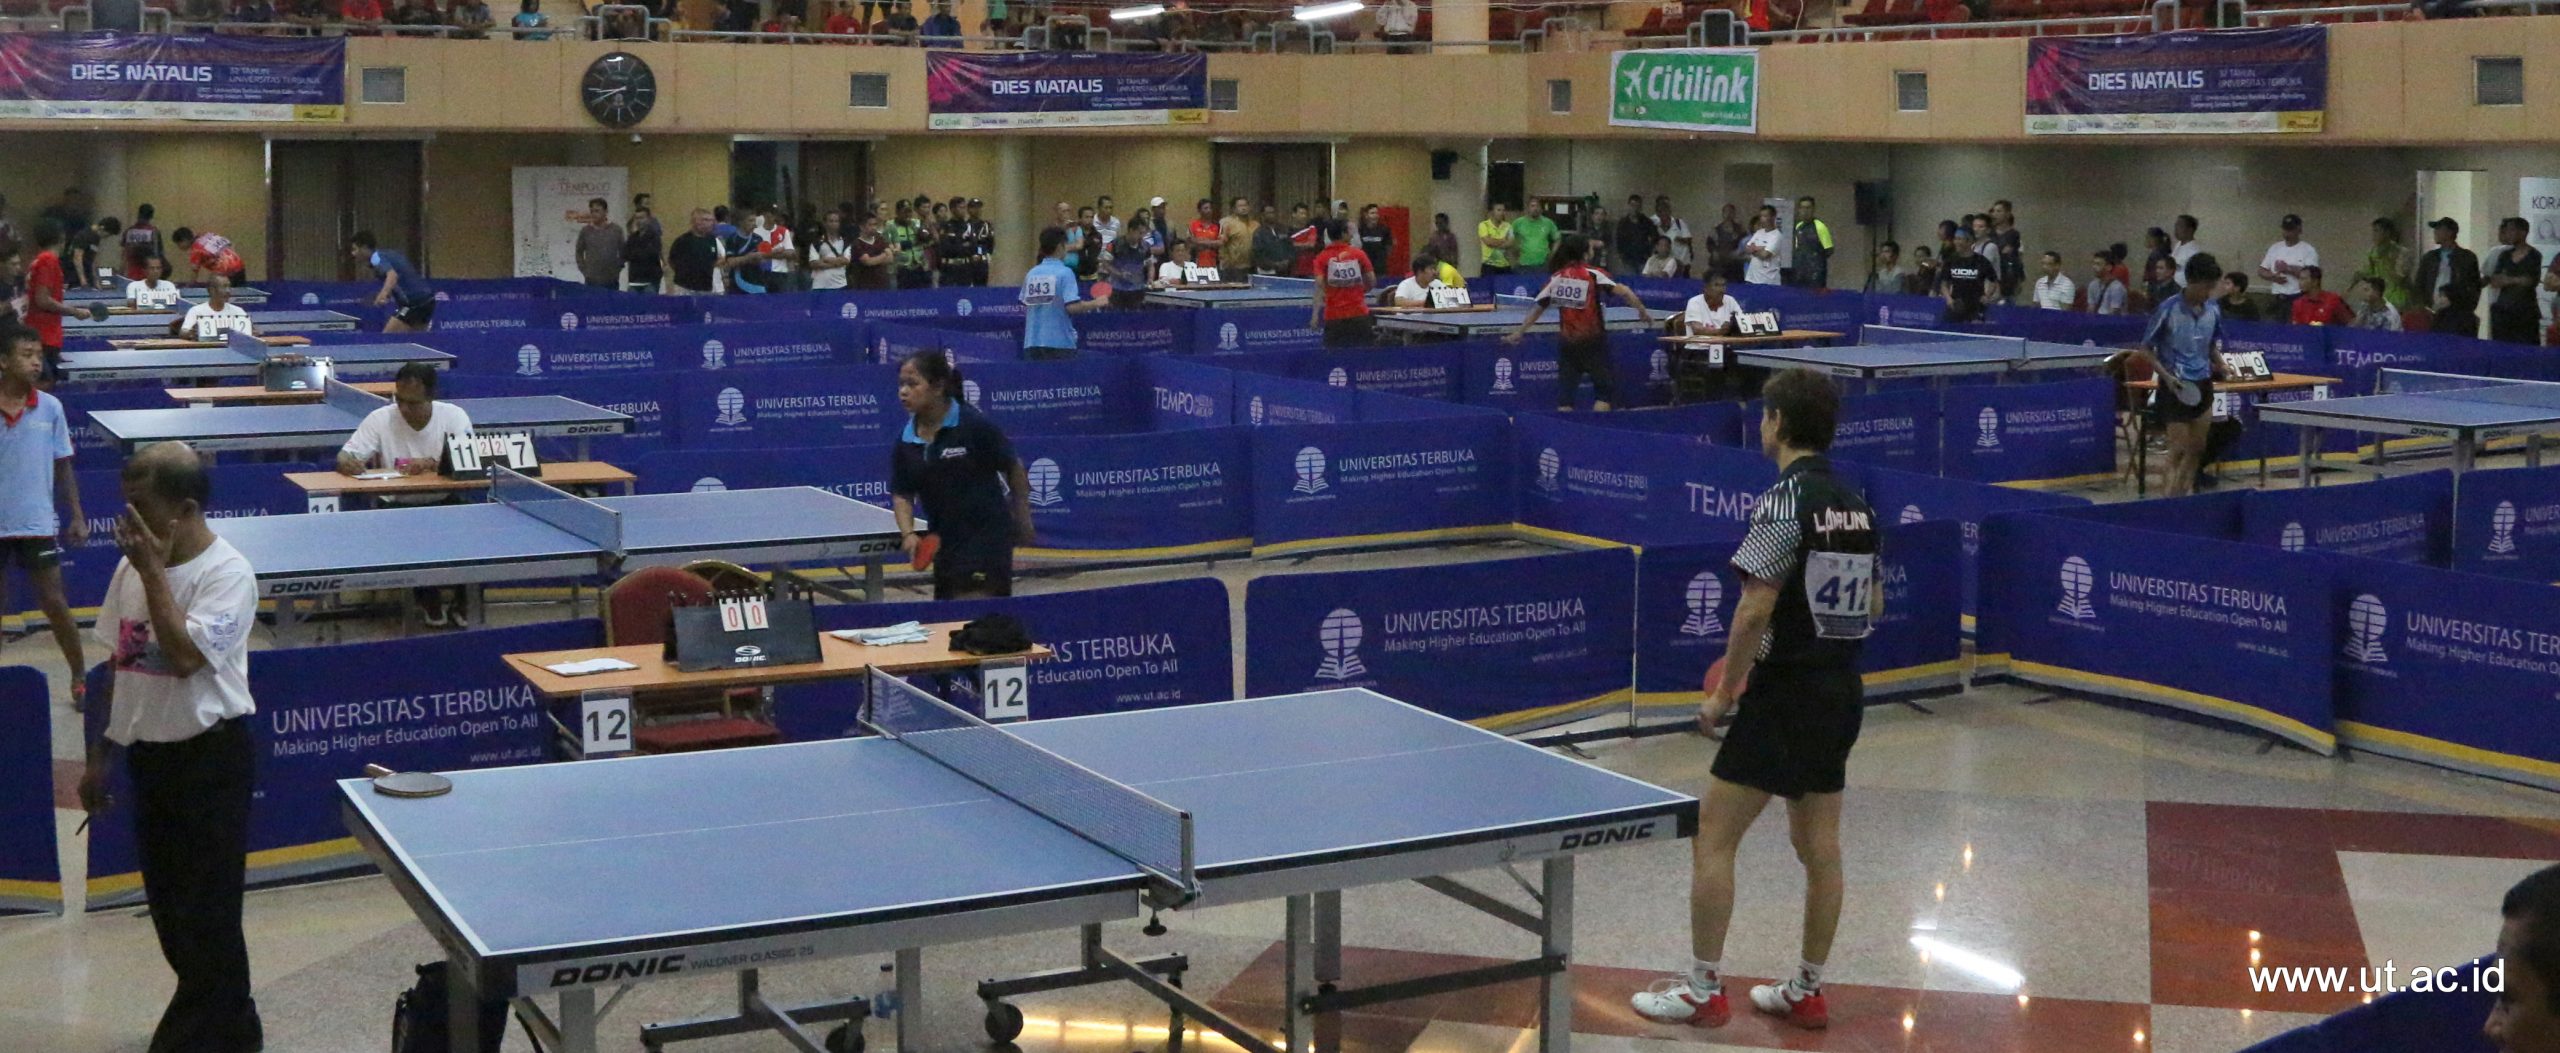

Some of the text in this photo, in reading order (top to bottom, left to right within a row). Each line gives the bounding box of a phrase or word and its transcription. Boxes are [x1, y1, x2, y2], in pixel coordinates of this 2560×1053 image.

[71, 64, 212, 82] DIES NATALIS
[2088, 70, 2204, 90] DIES NATALIS
[992, 78, 1103, 94] DIES NATALIS
[1647, 64, 1749, 104] Citilink
[1211, 266, 1217, 278] 8
[1333, 267, 1356, 278] 430
[1028, 282, 1050, 296] 843
[1555, 285, 1582, 299] 808
[142, 294, 149, 304] 8
[440, 319, 526, 329] UNIVERSITAS TERBUKA
[586, 313, 670, 324] UNIVERSITAS TERBUKA
[1741, 317, 1773, 333] 5 8
[205, 321, 211, 335] 3
[550, 351, 653, 364] UNIVERSITAS TERBUKA
[733, 344, 832, 357] UNIVERSITAS TERBUKA
[1713, 350, 1720, 360] 3
[2254, 356, 2265, 374] 9
[1355, 369, 1407, 381] UNIVERSITAS
[756, 394, 877, 410] UNIVERSITAS TERBUKA
[991, 385, 1101, 402] UNIVERSITAS TERBUKA
[1154, 387, 1194, 415] TEMPO
[2217, 399, 2223, 412] 2
[1873, 416, 1913, 432] TERBUKA
[2005, 407, 2093, 425] UNIVERSITAS TERBUKA
[567, 424, 614, 434] DONIC
[2411, 427, 2448, 438] DONIC
[454, 438, 526, 468] 11 2 2 7
[1340, 449, 1475, 472] UNIVERSITAS TERBUKA
[1075, 461, 1221, 486] UNIVERSITAS TERBUKA
[1567, 466, 1623, 486] UNIVERSITAS
[2315, 520, 2380, 545] UNIVERSITAS
[2381, 512, 2425, 534] TERBUKA
[269, 578, 344, 595] DONIC
[2110, 571, 2288, 616] UNIVERSITAS TERBUKA
[728, 604, 762, 628] 0 0
[1384, 597, 1586, 635] UNIVERSITAS TERBUKA
[2109, 593, 2288, 634] Making Higher Education Open To All
[1384, 620, 1586, 654] Making Higher Education Open To All
[2407, 611, 2523, 651] UNIVERSITAS
[1078, 632, 1176, 662] TERBUKA
[2406, 636, 2546, 674] Making Higher Education
[1036, 658, 1178, 685] Education Open To All
[987, 677, 1023, 708] 12
[1116, 688, 1181, 704] www.ut.ac.id
[272, 684, 536, 735] UNIVERSITAS TERBUKA
[586, 709, 627, 741] 12
[273, 712, 538, 757] Making Higher Education Open To All
[469, 745, 541, 764] www.ut.ac.id
[1559, 822, 1655, 851] DONIC
[550, 953, 686, 988] DONIC
